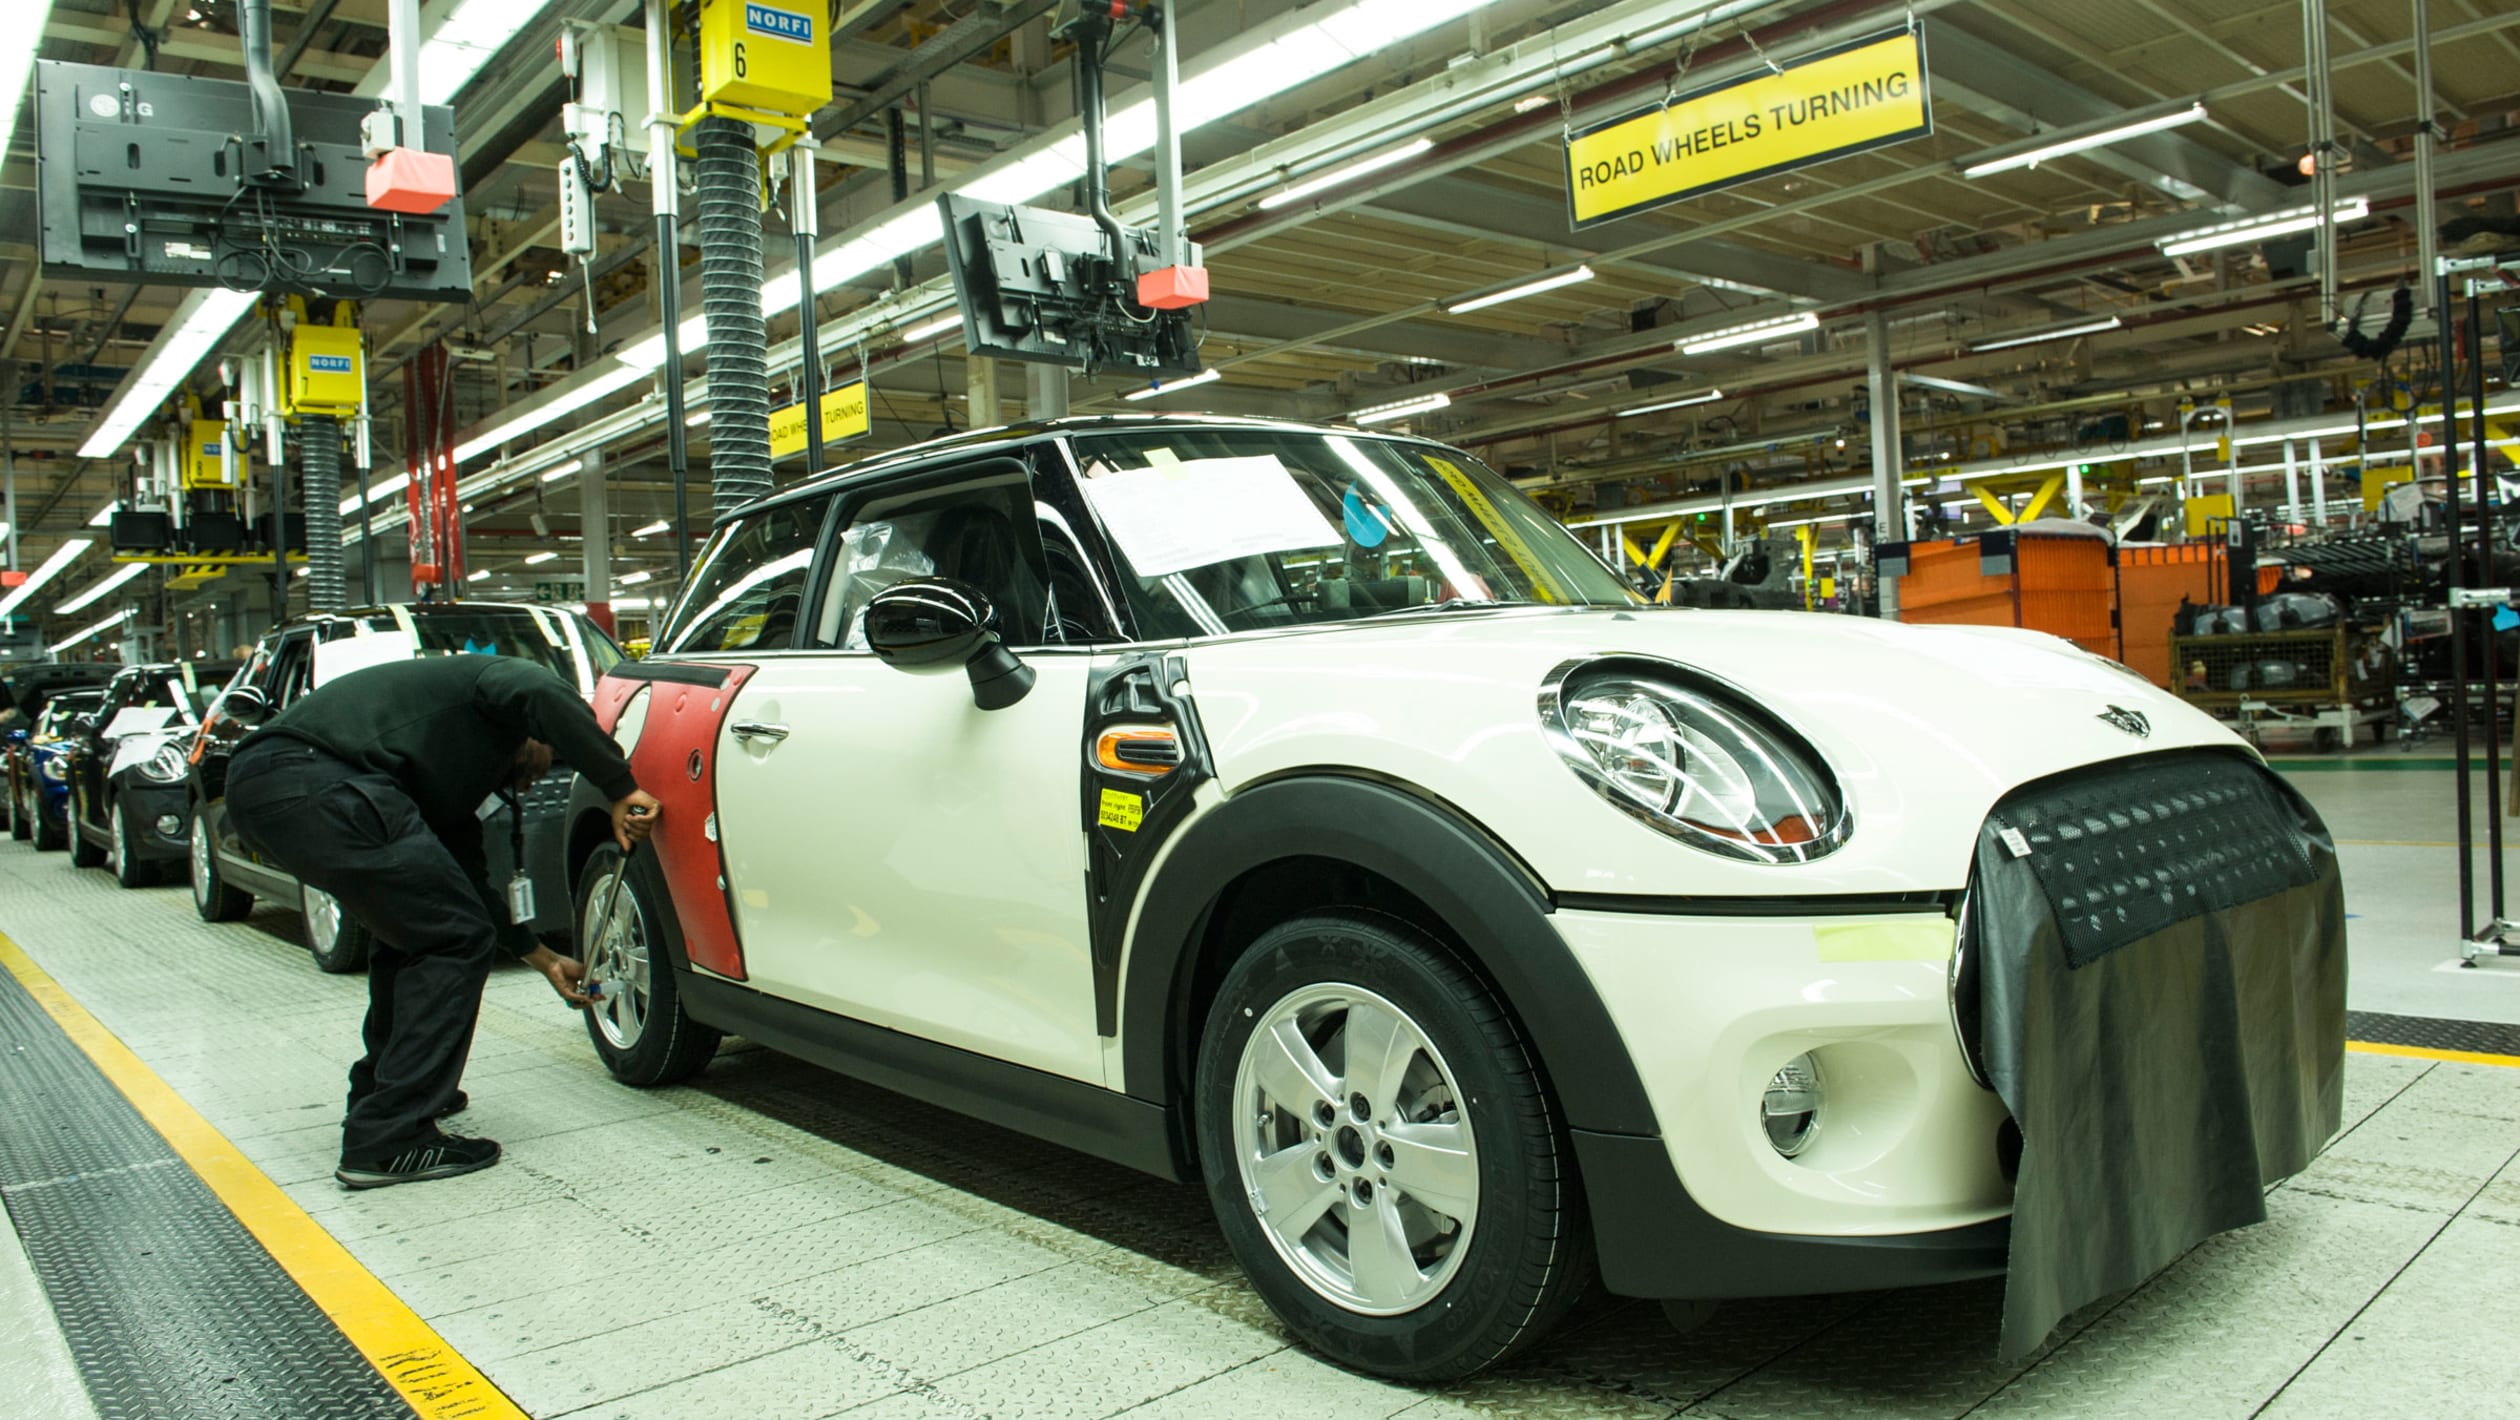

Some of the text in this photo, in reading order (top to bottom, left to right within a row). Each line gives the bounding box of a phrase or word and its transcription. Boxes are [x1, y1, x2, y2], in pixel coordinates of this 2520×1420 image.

[748, 8, 809, 35] NORFI
[735, 42, 746, 78] 6
[1580, 71, 1908, 190] ROAD WHEELS TURNING
[311, 358, 350, 368] NORFI
[770, 426, 789, 441] OAD
[824, 401, 864, 424] TURNING
